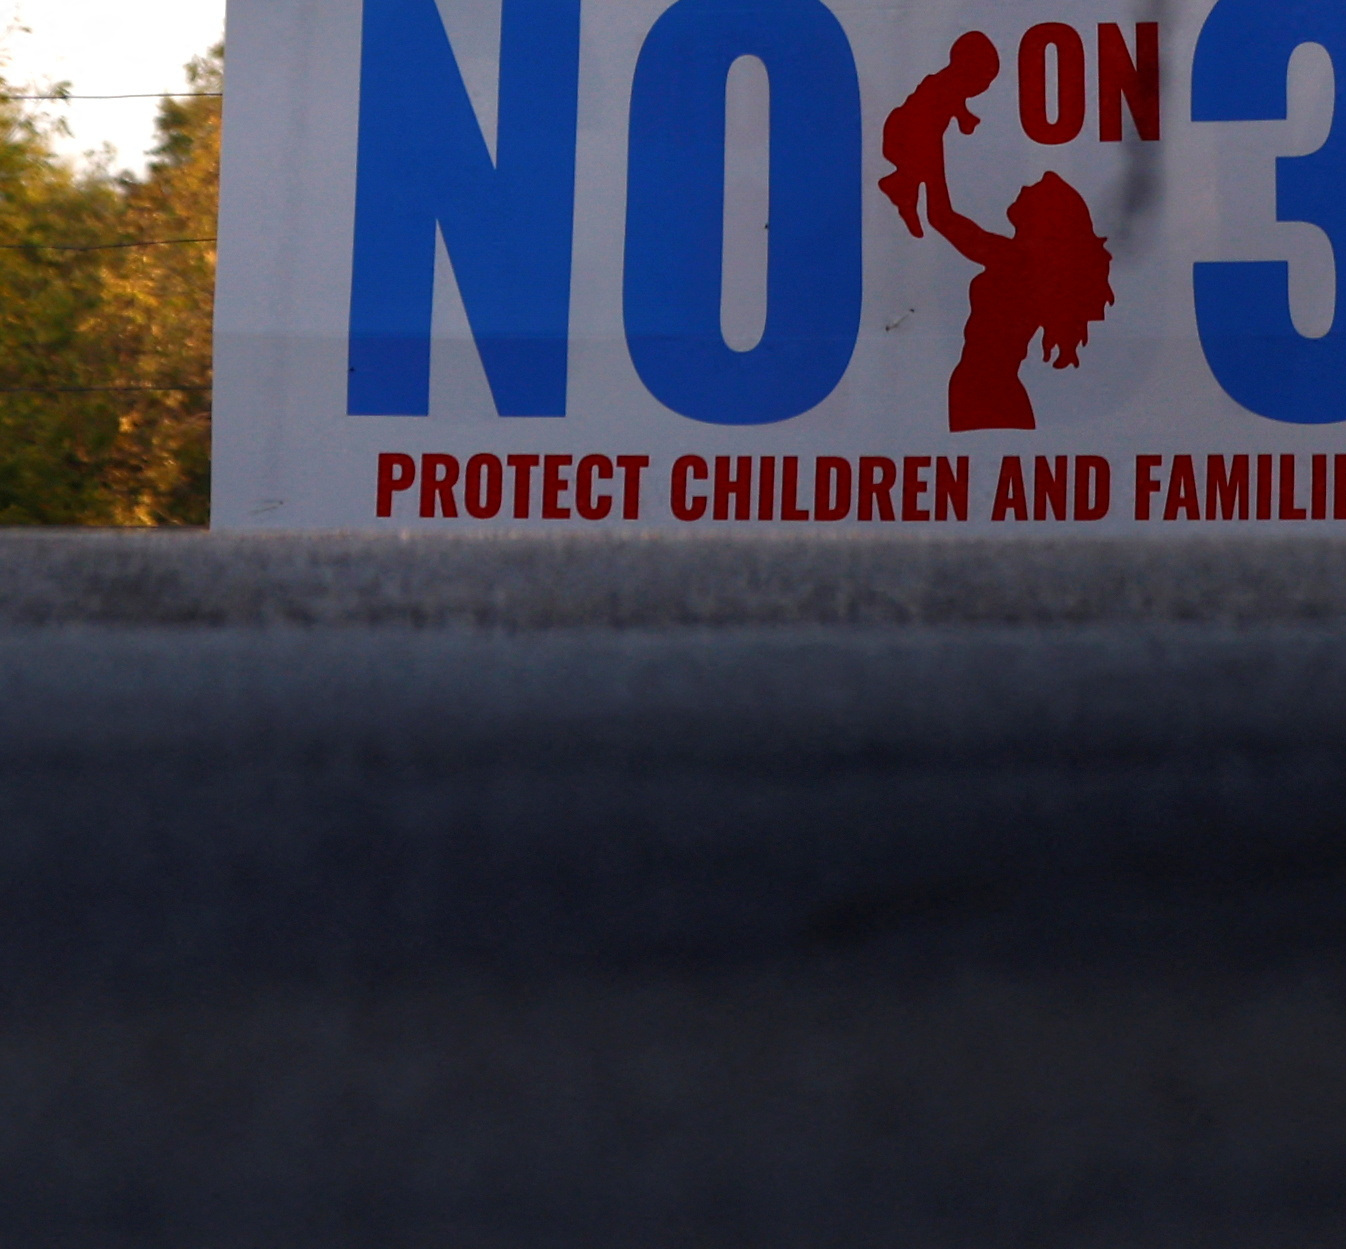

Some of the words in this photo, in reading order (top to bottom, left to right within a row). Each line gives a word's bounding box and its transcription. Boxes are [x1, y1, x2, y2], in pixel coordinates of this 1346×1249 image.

[1018, 21, 1160, 145] ON
[376, 453, 650, 521] PROTECT
[670, 454, 969, 522] CHILDREN
[991, 455, 1111, 522] AND
